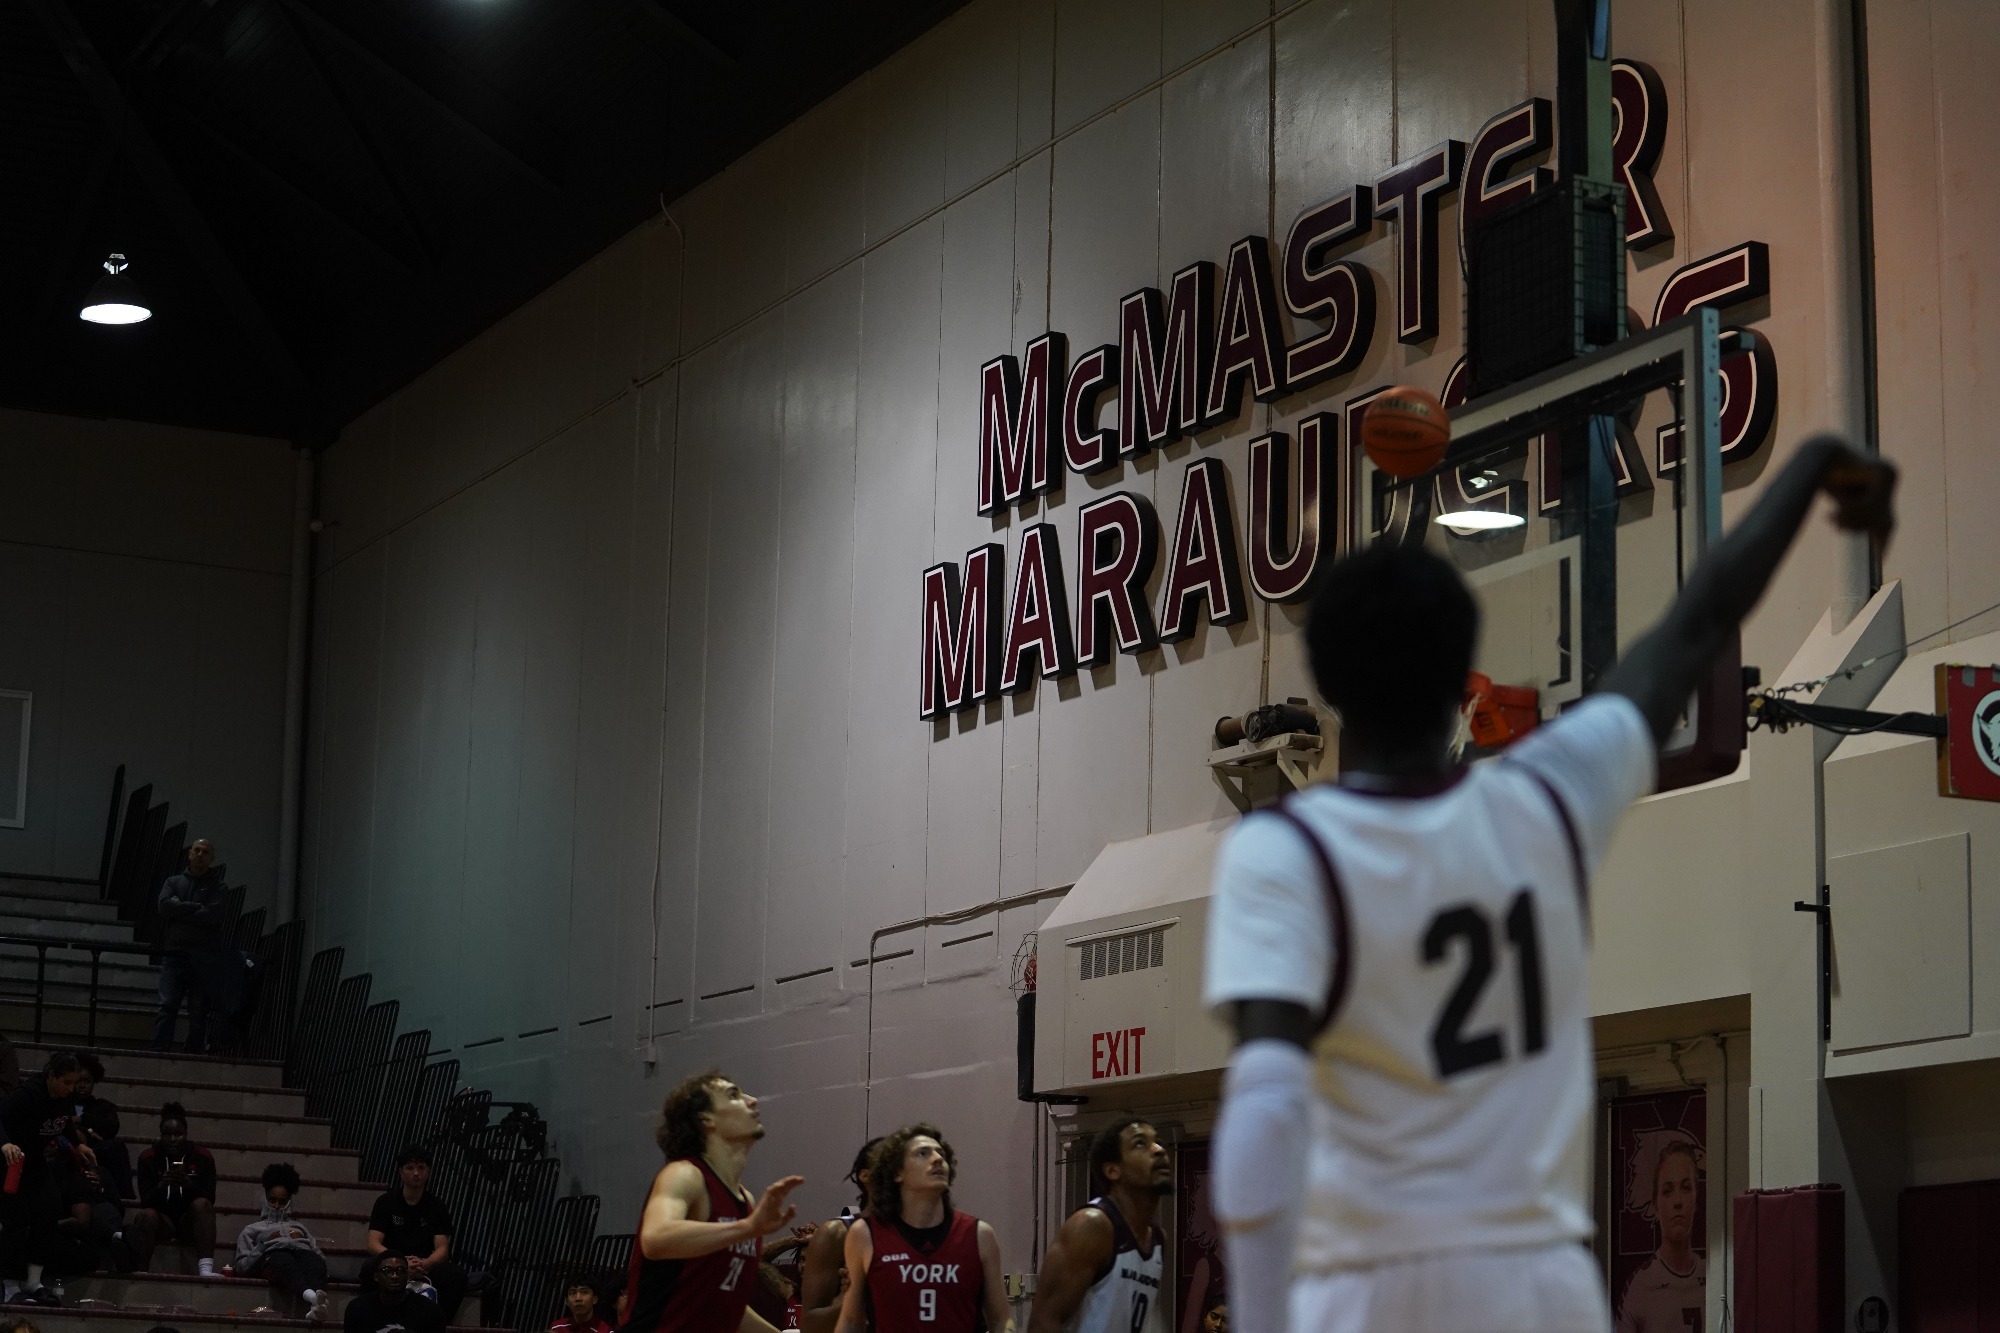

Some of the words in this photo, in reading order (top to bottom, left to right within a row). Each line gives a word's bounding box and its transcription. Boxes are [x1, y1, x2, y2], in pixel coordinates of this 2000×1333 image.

[1424, 888, 1544, 1077] 21
[1092, 1026, 1146, 1079] EXIT
[727, 1237, 758, 1258] ORK
[719, 1256, 746, 1292] 21
[898, 1263, 960, 1284] YORK
[919, 1288, 937, 1322] 9
